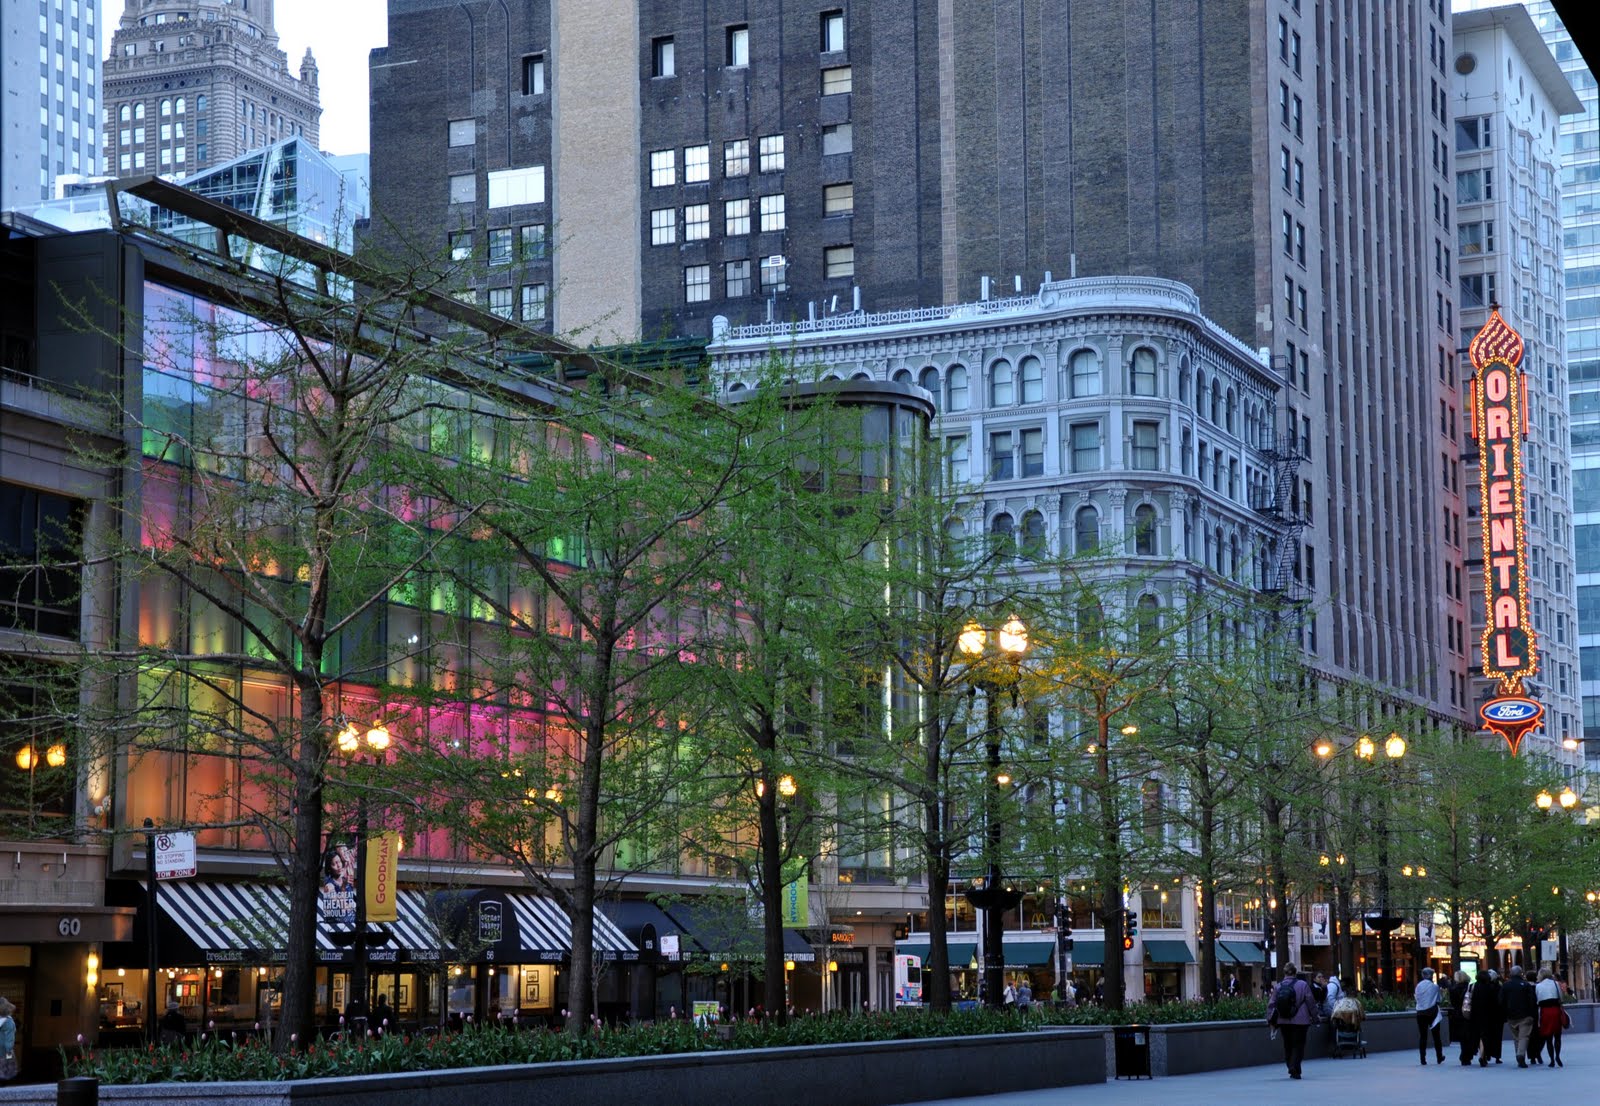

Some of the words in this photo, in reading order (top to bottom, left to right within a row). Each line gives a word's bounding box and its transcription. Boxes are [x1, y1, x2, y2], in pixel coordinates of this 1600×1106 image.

[1486, 369, 1520, 668] ORIENTAL
[1498, 705, 1525, 717] Ford
[175, 869, 191, 877] ZONE
[376, 837, 389, 904] GOODMAN
[322, 899, 355, 910] THEATER
[790, 880, 799, 923] OODMAN
[59, 918, 81, 936] 60
[206, 949, 242, 961] breakfast
[320, 950, 344, 961] dinner
[369, 950, 397, 961] catering
[410, 950, 440, 960] breakfast
[486, 950, 495, 960] 56
[540, 951, 563, 961] catering
